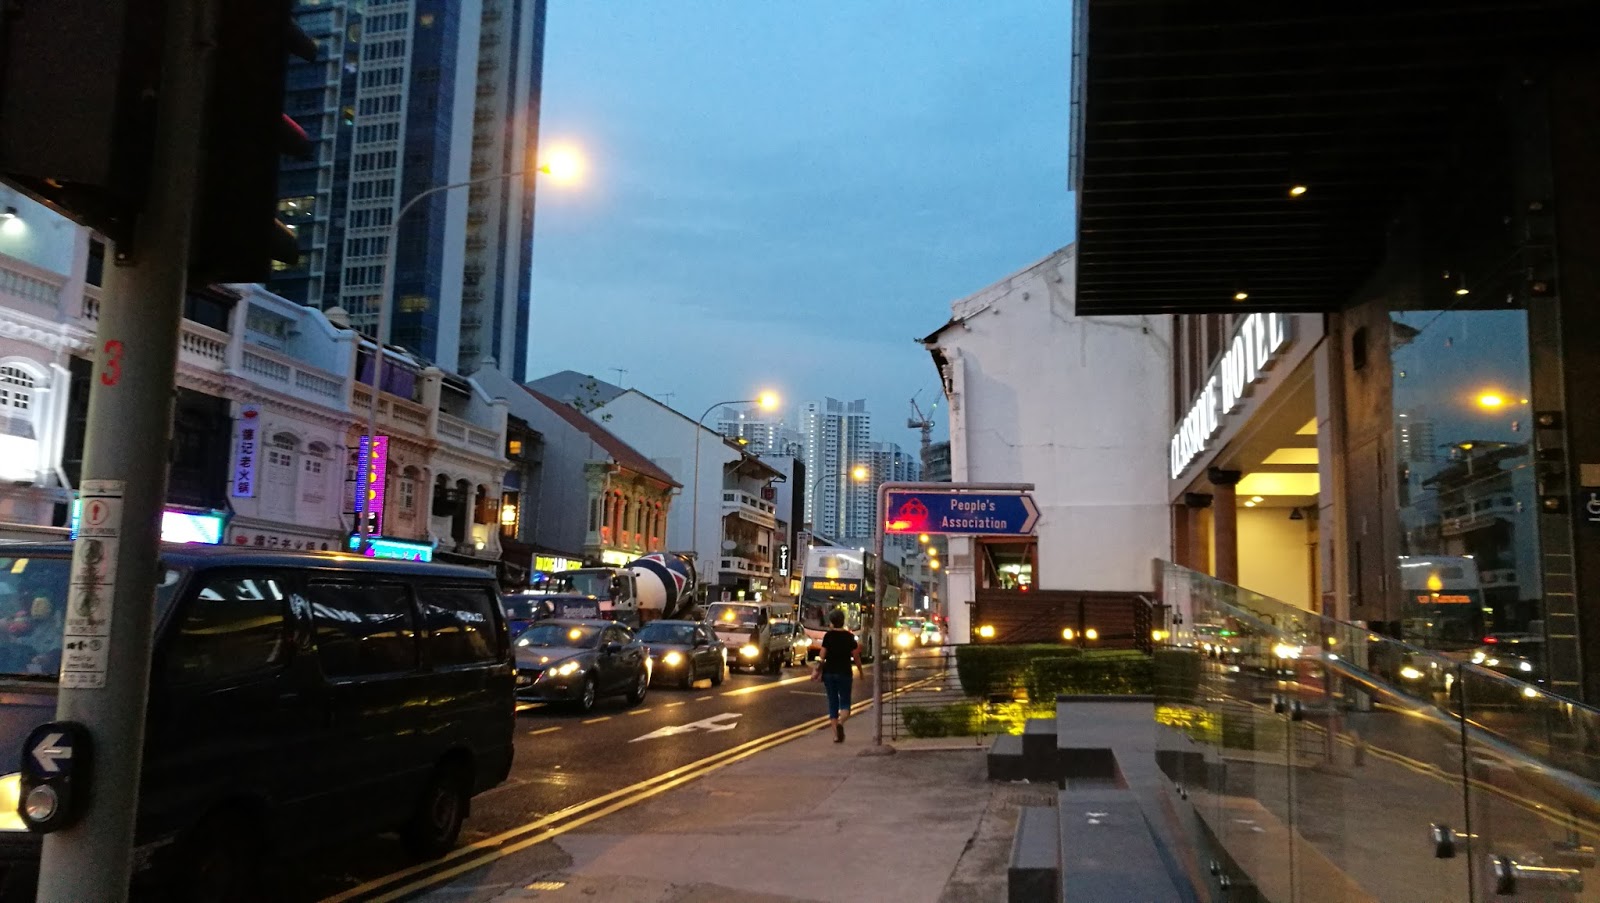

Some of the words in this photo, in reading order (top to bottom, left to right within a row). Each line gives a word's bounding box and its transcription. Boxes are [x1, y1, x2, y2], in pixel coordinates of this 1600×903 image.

[101, 340, 122, 387] 3
[1171, 375, 1218, 479] CLASSIQUE
[1221, 312, 1284, 414] HOTEL
[950, 499, 995, 513] People's
[942, 515, 1007, 529] Association
[848, 583, 858, 592] 67
